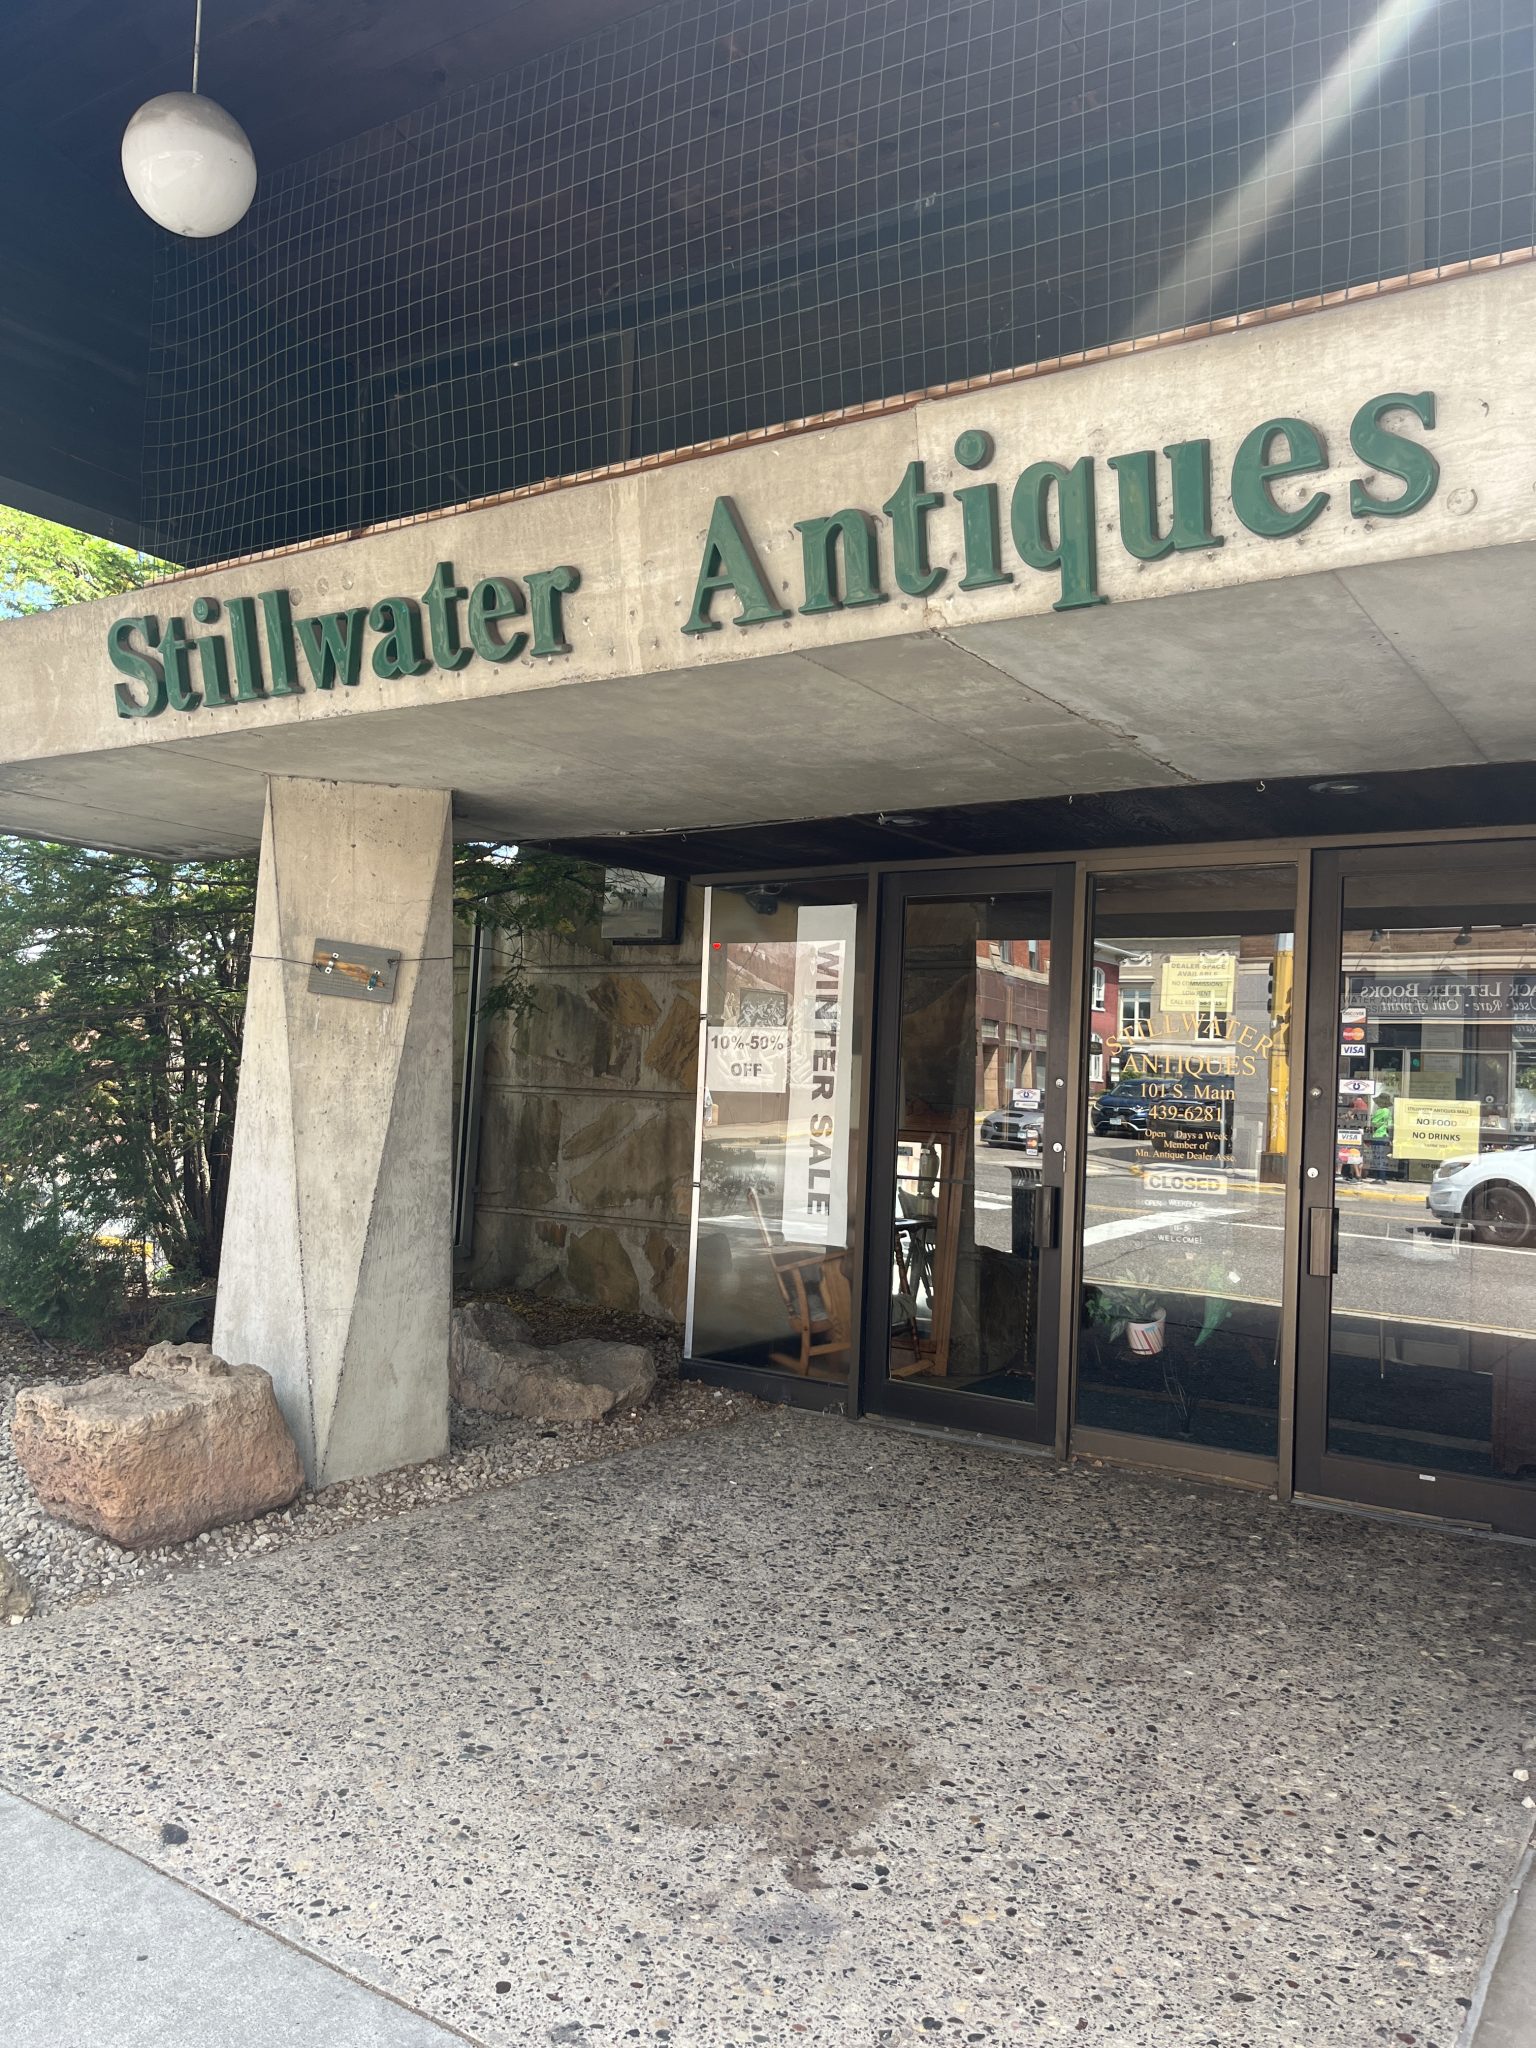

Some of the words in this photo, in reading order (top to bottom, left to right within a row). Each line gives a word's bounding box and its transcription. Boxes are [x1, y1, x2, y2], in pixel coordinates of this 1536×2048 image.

[108, 561, 580, 718] Stillwater
[680, 391, 1440, 633] Antiques
[811, 942, 840, 1101] WINTER
[711, 1034, 784, 1051] 10%-50%
[1106, 1013, 1273, 1060] STILLWATER
[1343, 1046, 1364, 1054] VISA
[730, 1062, 762, 1077] OFF
[1122, 1054, 1256, 1080] ANTIQUES
[1140, 1082, 1167, 1098] 101
[1173, 1083, 1188, 1099] S.
[1193, 1084, 1236, 1101] Main
[1148, 1104, 1223, 1122] 439-6281
[1432, 1119, 1458, 1127] FOOD
[1145, 1128, 1167, 1140] Open
[1175, 1130, 1196, 1141] Days
[1205, 1131, 1228, 1141] Week
[1341, 1133, 1358, 1141] VISA
[1412, 1131, 1426, 1139] NO
[1428, 1132, 1461, 1142] DRINKS
[1163, 1140, 1197, 1149] Member
[1199, 1142, 1209, 1150] of
[1152, 1150, 1185, 1160] Antique
[1186, 1151, 1213, 1160] Dealer
[807, 1113, 833, 1216] SALE
[1149, 1175, 1220, 1192] CLOSED
[1157, 1234, 1204, 1244] WELCOME!
